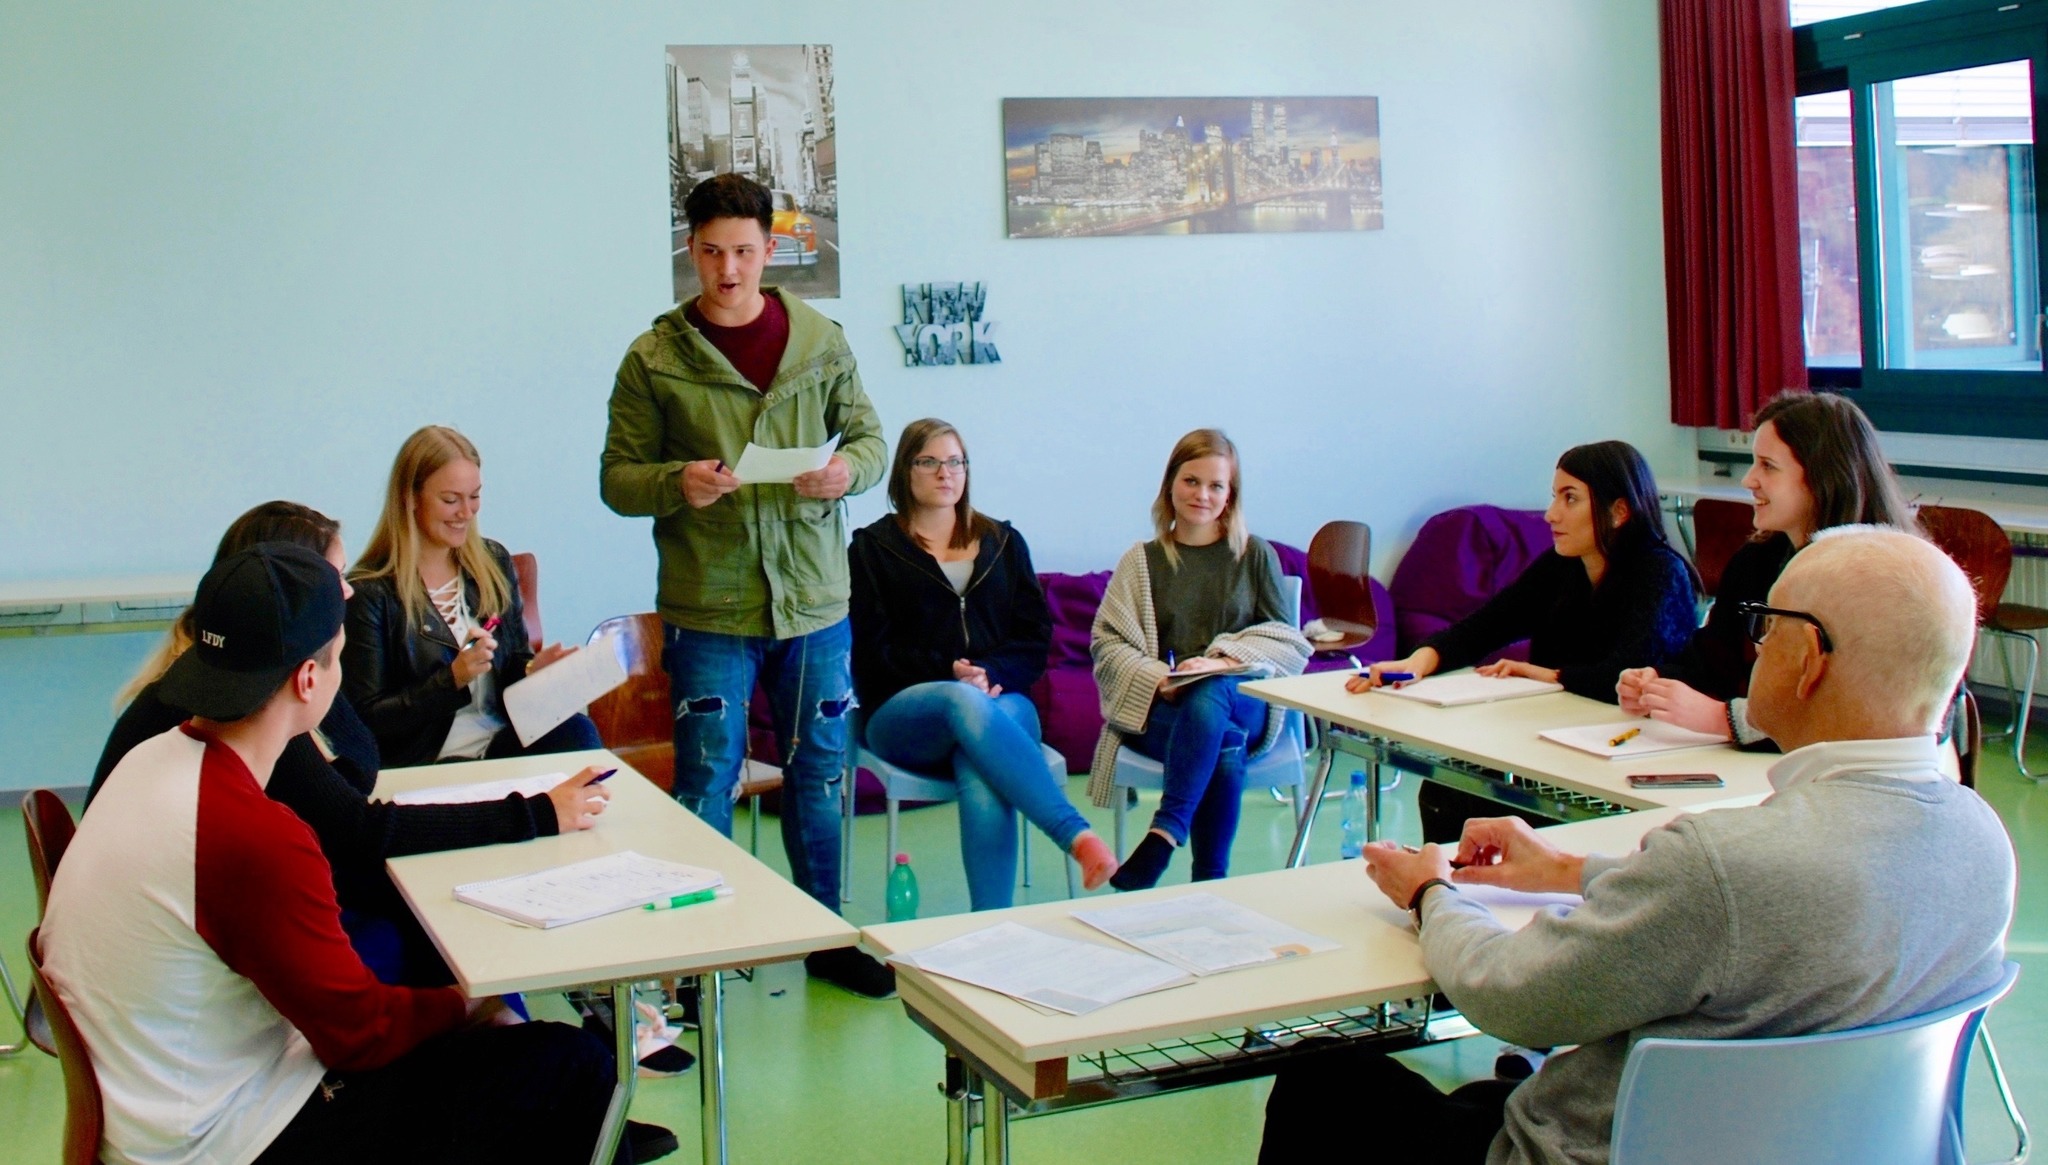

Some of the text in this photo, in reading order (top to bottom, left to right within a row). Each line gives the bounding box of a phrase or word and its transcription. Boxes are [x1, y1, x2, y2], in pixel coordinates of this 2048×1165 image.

[902, 281, 988, 325] NEW
[893, 322, 1001, 367] YORK
[202, 630, 226, 649] LFDY
